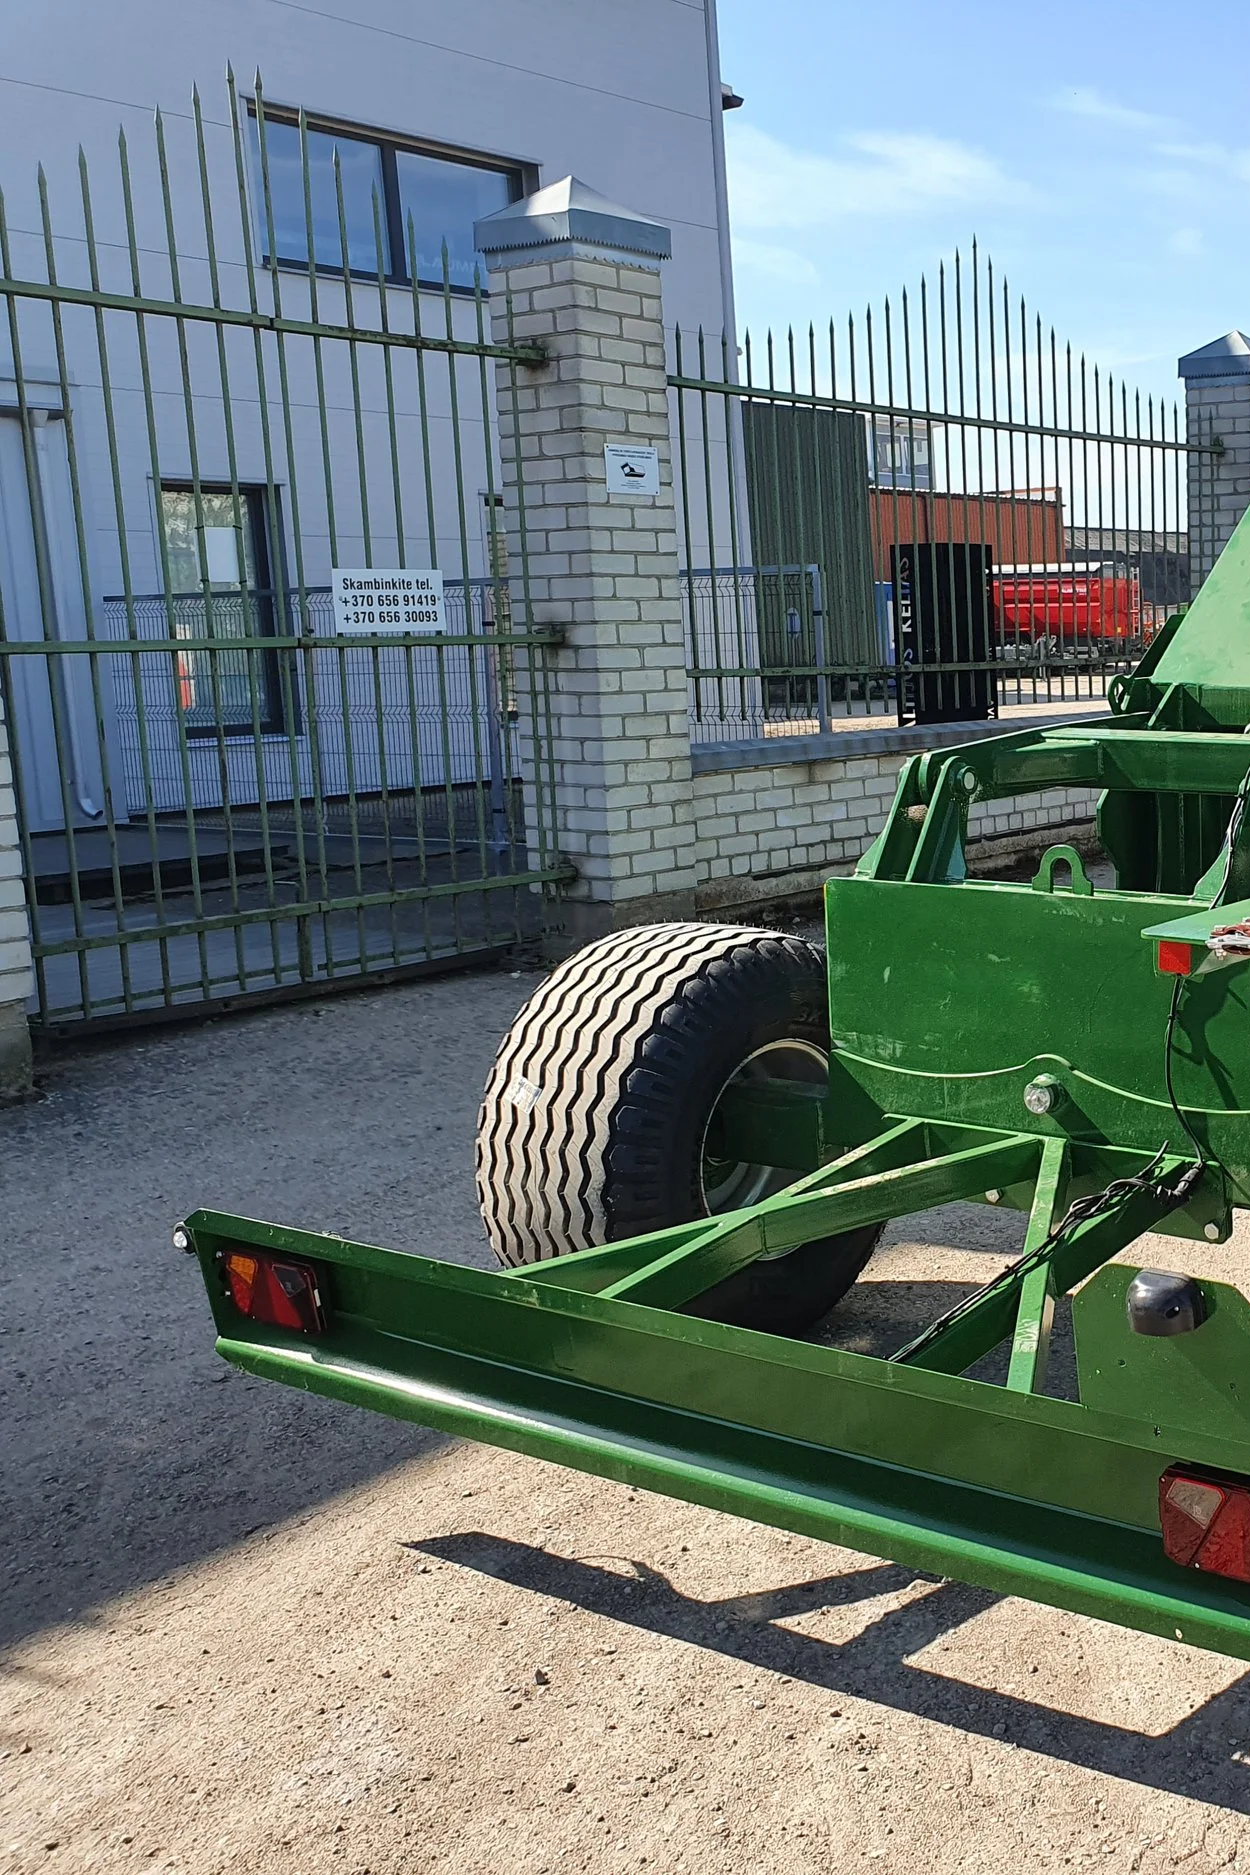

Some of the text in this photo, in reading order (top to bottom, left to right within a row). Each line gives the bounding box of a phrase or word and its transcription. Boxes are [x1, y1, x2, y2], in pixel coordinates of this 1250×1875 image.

[342, 577, 433, 590] Skambinkite tel.
[342, 594, 437, 607] +370 656 91419
[343, 610, 438, 624] +370 656 30093
